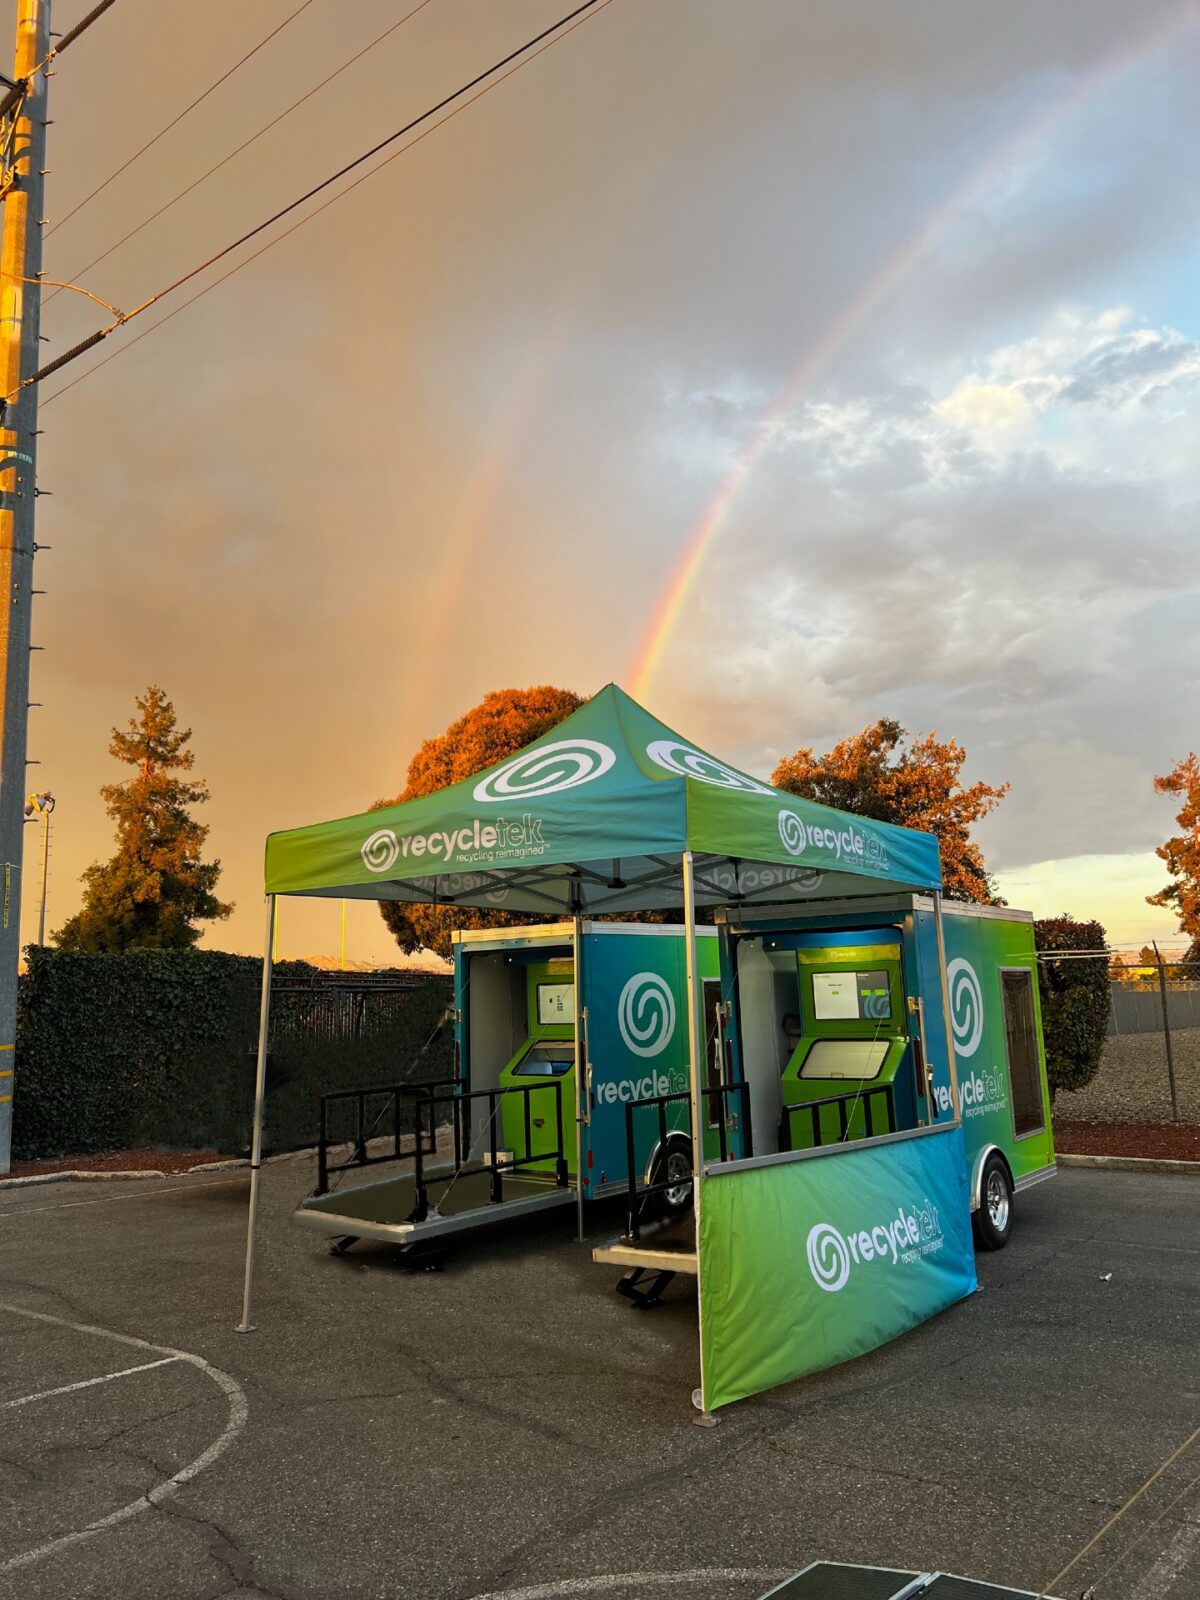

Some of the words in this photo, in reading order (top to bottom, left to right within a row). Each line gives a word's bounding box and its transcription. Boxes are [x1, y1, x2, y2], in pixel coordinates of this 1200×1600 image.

[401, 813, 545, 861] recycletek
[456, 850, 494, 863] recycling
[847, 1198, 942, 1265] recycletek
